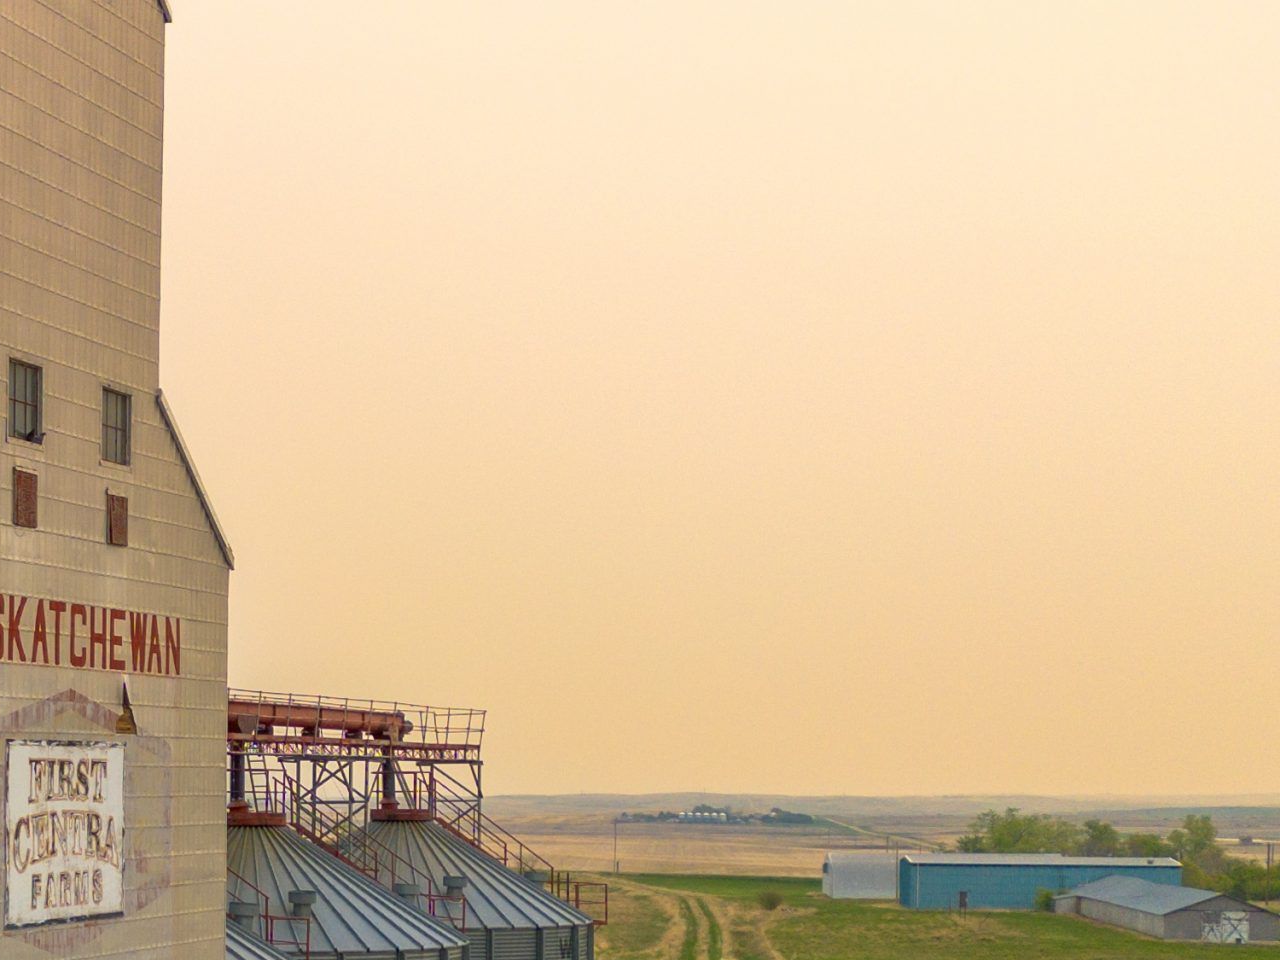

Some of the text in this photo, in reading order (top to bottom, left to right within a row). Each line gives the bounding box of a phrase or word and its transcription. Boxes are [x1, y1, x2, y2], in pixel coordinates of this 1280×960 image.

[28, 757, 108, 804] FIRST
[12, 809, 120, 874] CENTRA
[30, 868, 104, 910] FARMS
